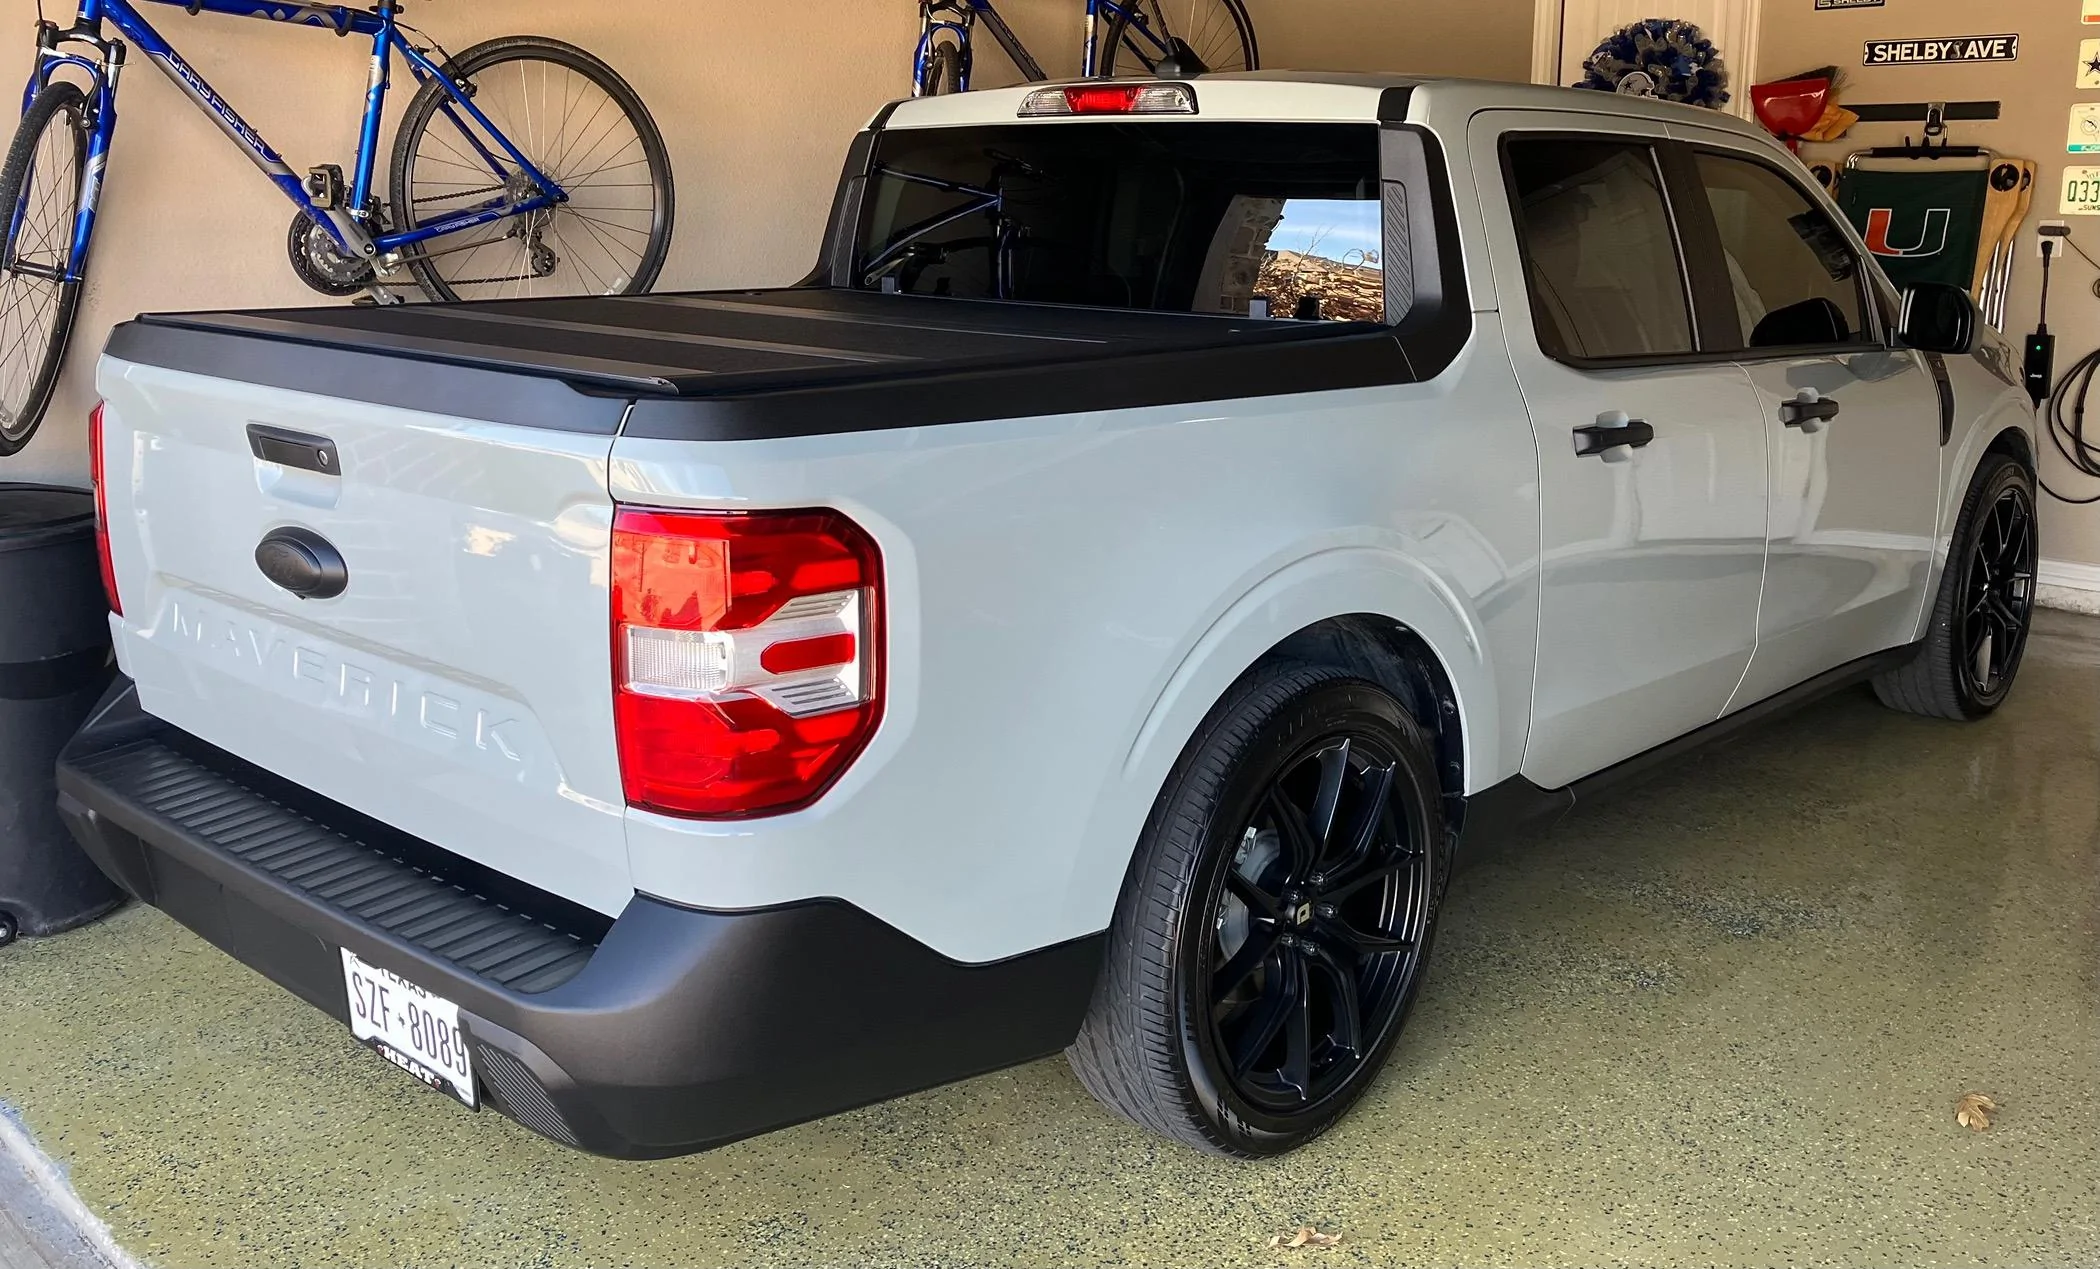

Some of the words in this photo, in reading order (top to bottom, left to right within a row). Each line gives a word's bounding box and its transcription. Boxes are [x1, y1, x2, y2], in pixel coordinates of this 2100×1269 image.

[1873, 41, 1952, 62] SHELBY
[1964, 39, 2007, 59] AVE
[211, 95, 265, 155] FISHER
[1863, 208, 1951, 258] U
[172, 602, 521, 762] MAVERICK
[383, 1045, 436, 1086] HEAT
